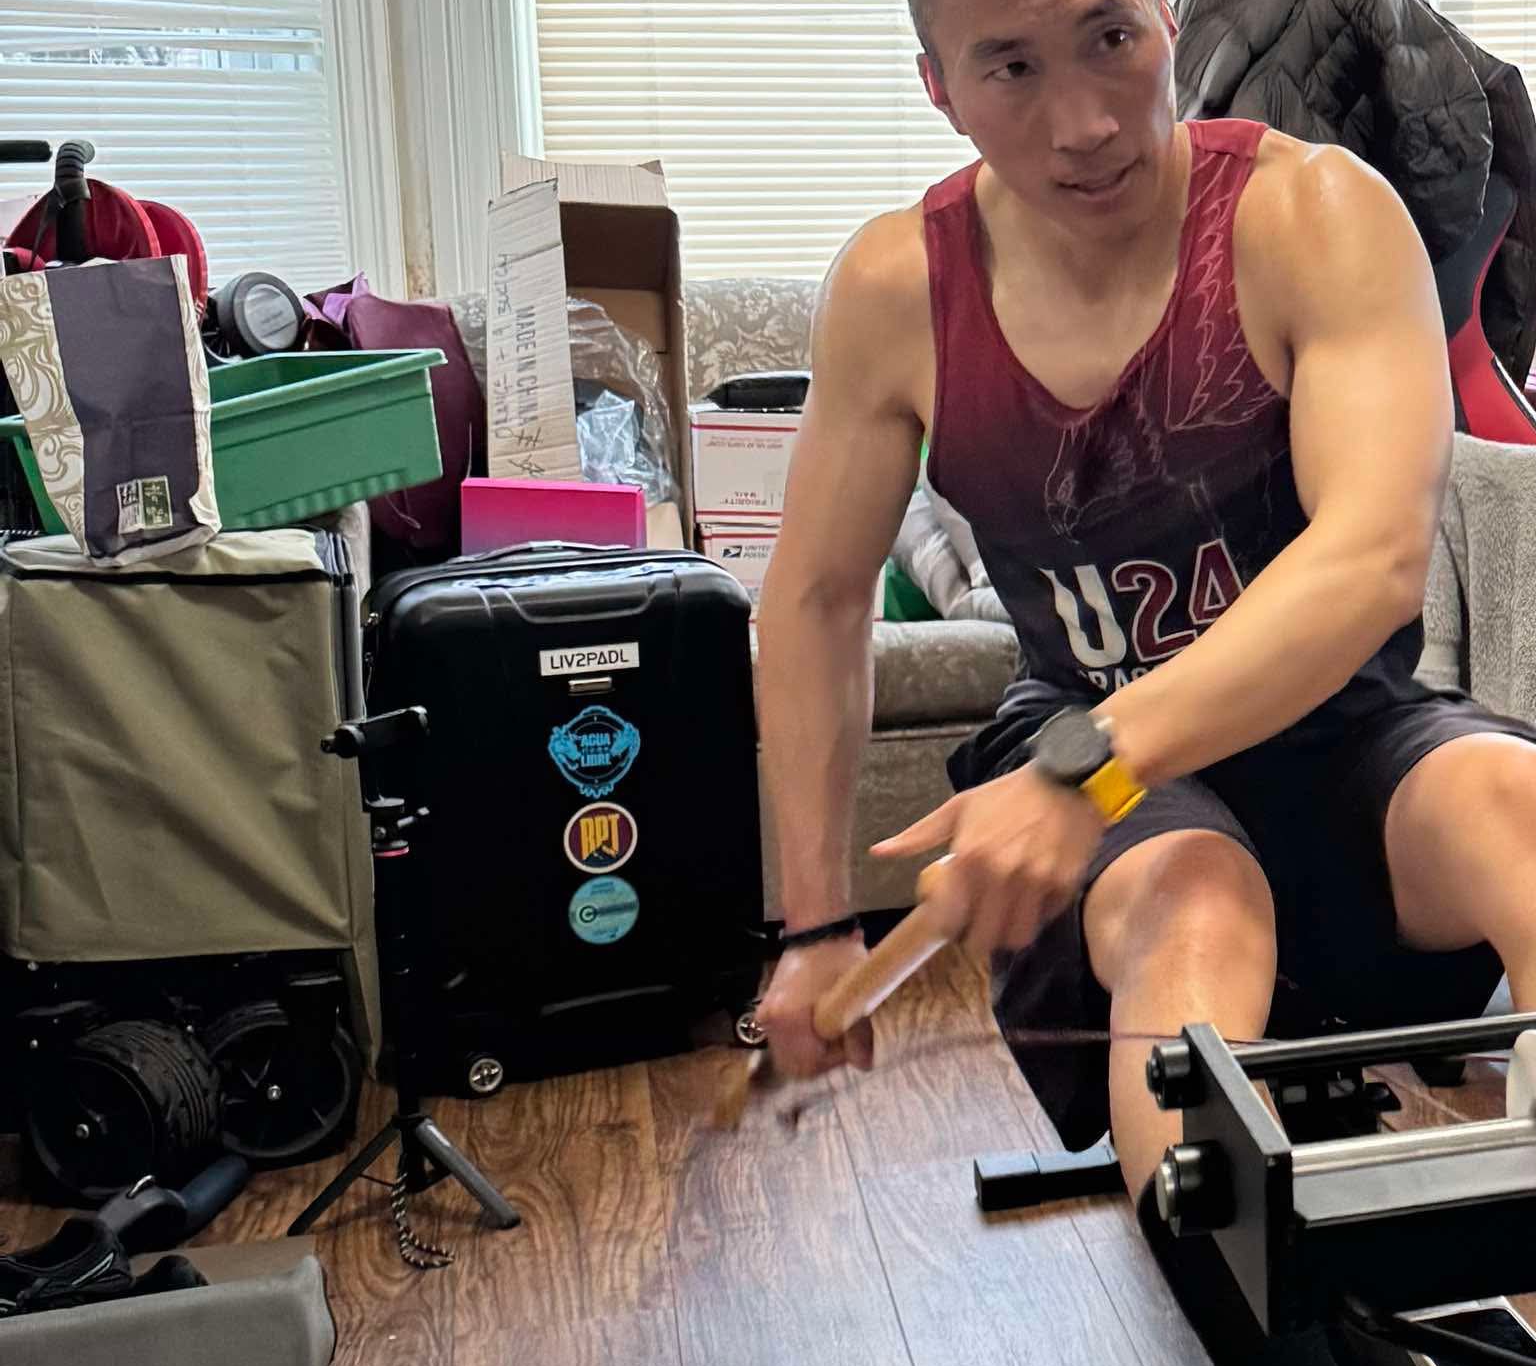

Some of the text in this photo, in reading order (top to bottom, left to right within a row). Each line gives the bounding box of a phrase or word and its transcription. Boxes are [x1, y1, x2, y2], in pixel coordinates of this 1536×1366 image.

[516, 305, 536, 354] MADE
[517, 357, 538, 374] IN
[516, 375, 538, 427] CHINA
